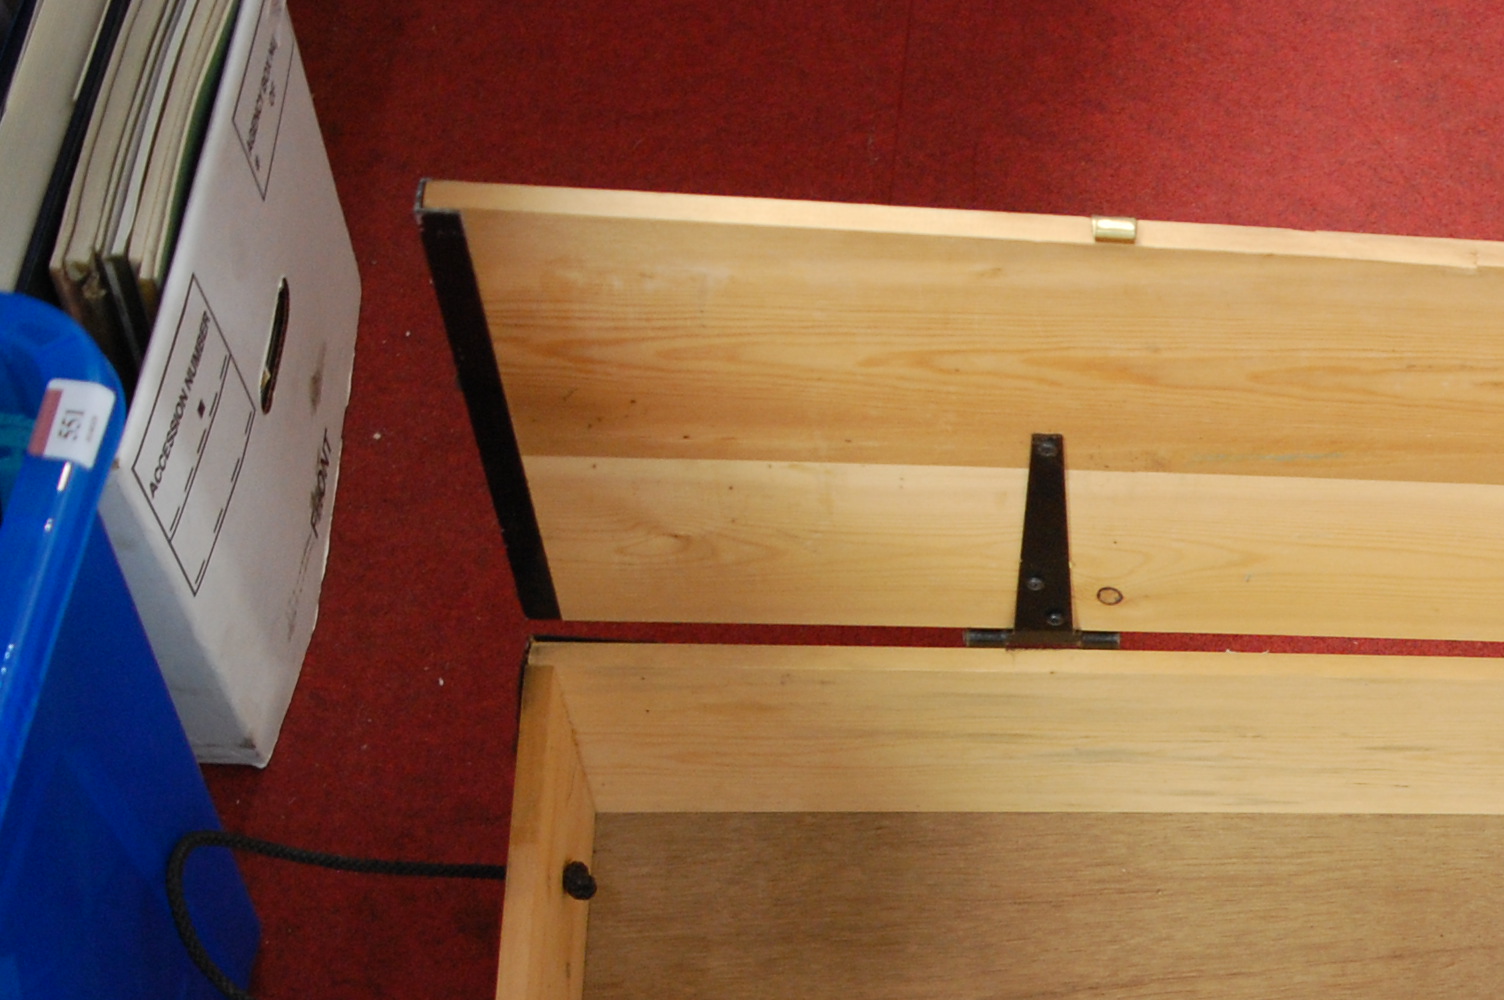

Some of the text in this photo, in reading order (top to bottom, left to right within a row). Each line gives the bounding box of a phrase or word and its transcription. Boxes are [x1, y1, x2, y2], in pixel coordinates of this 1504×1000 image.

[58, 409, 84, 440] 551
[149, 310, 211, 499] ACCESSION NUMBER
